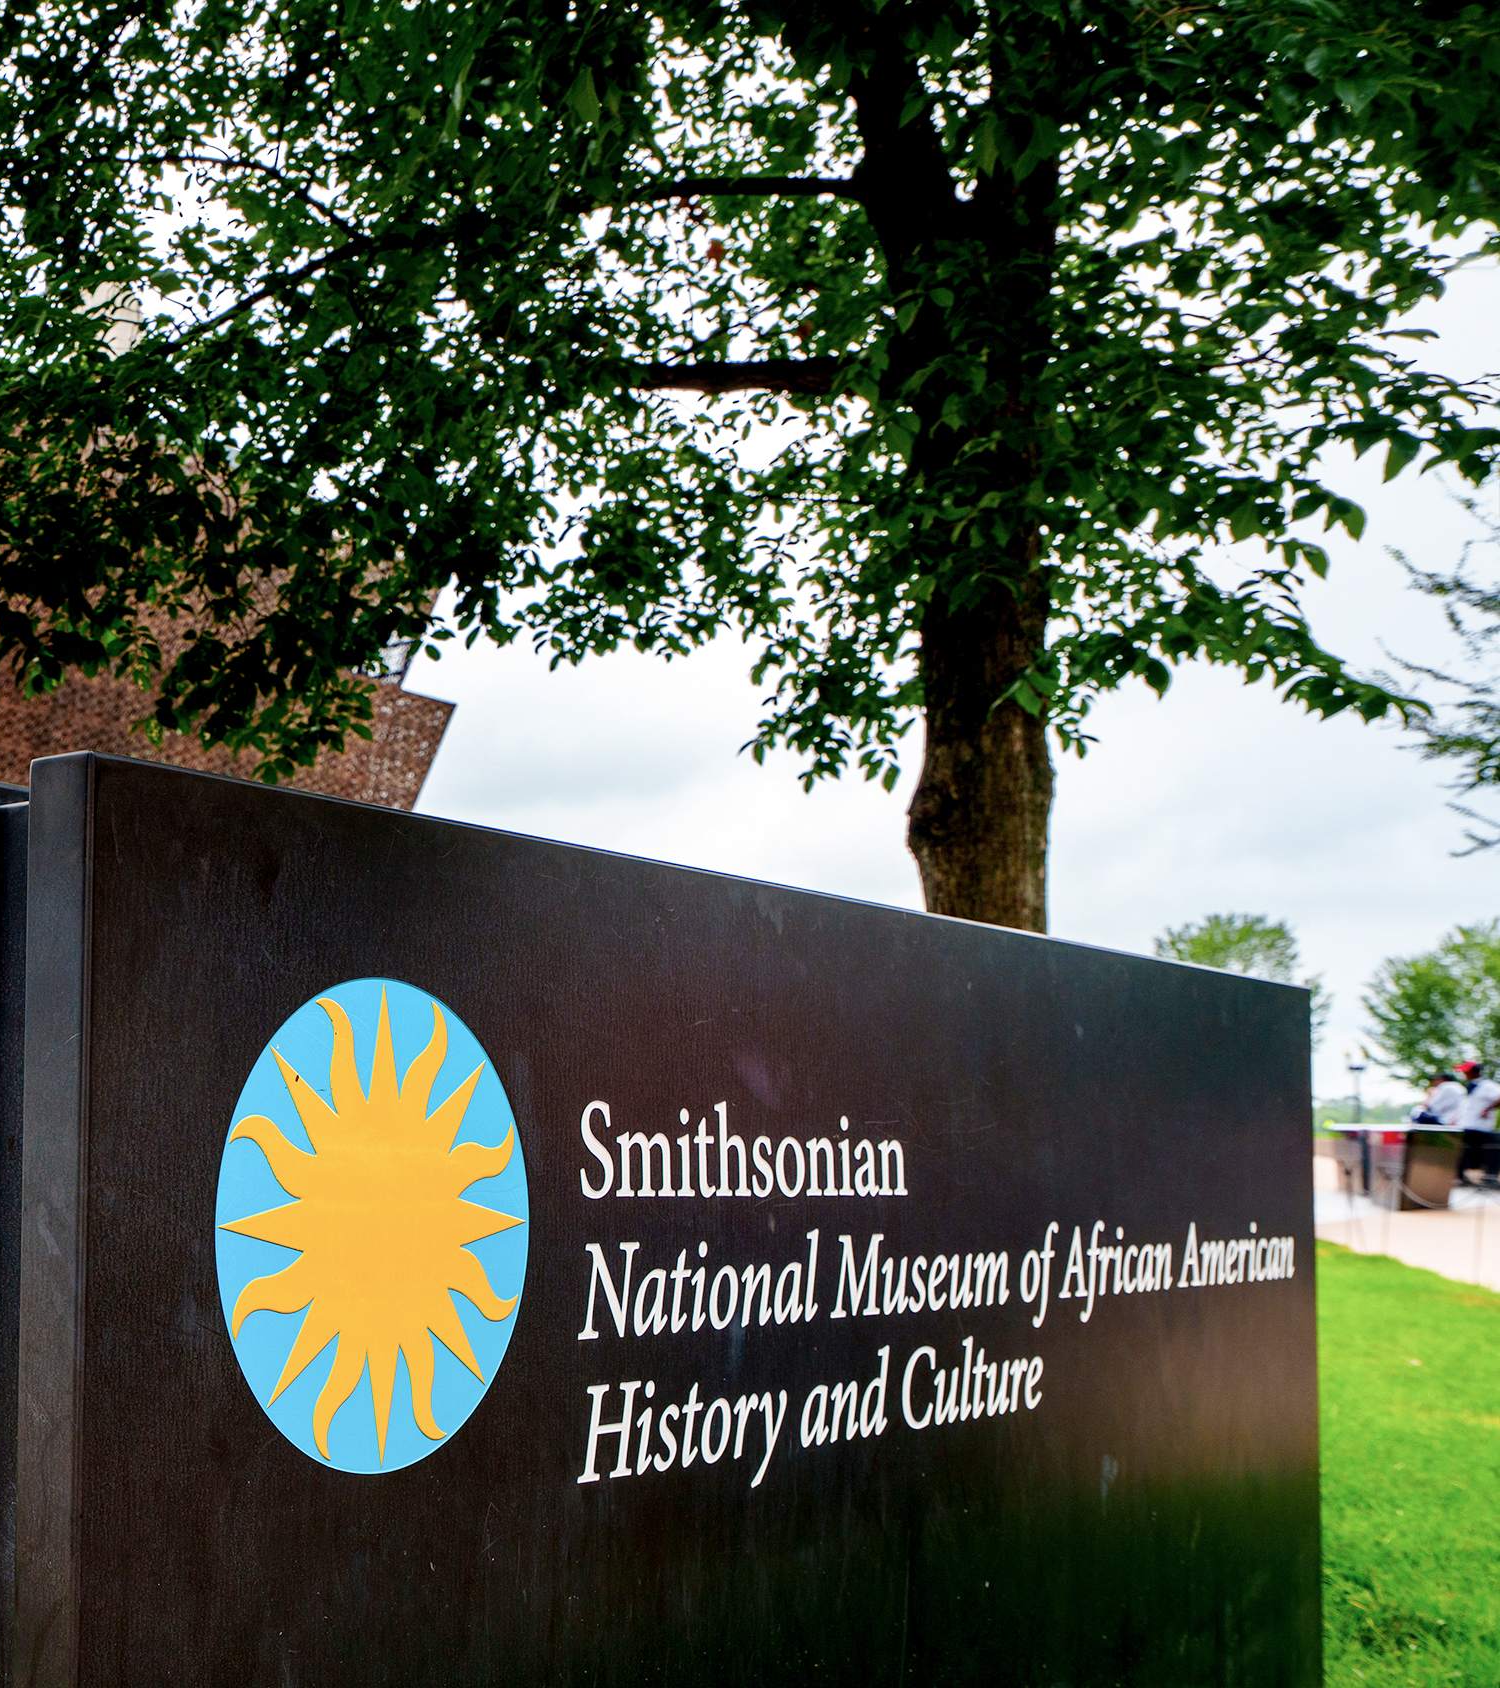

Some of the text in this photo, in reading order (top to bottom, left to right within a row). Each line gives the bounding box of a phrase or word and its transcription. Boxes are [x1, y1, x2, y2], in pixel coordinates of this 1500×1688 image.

[579, 1100, 909, 1200] Smithsonian
[577, 1219, 1296, 1341] National Museum of African American
[576, 1335, 1044, 1489] History and Culture
